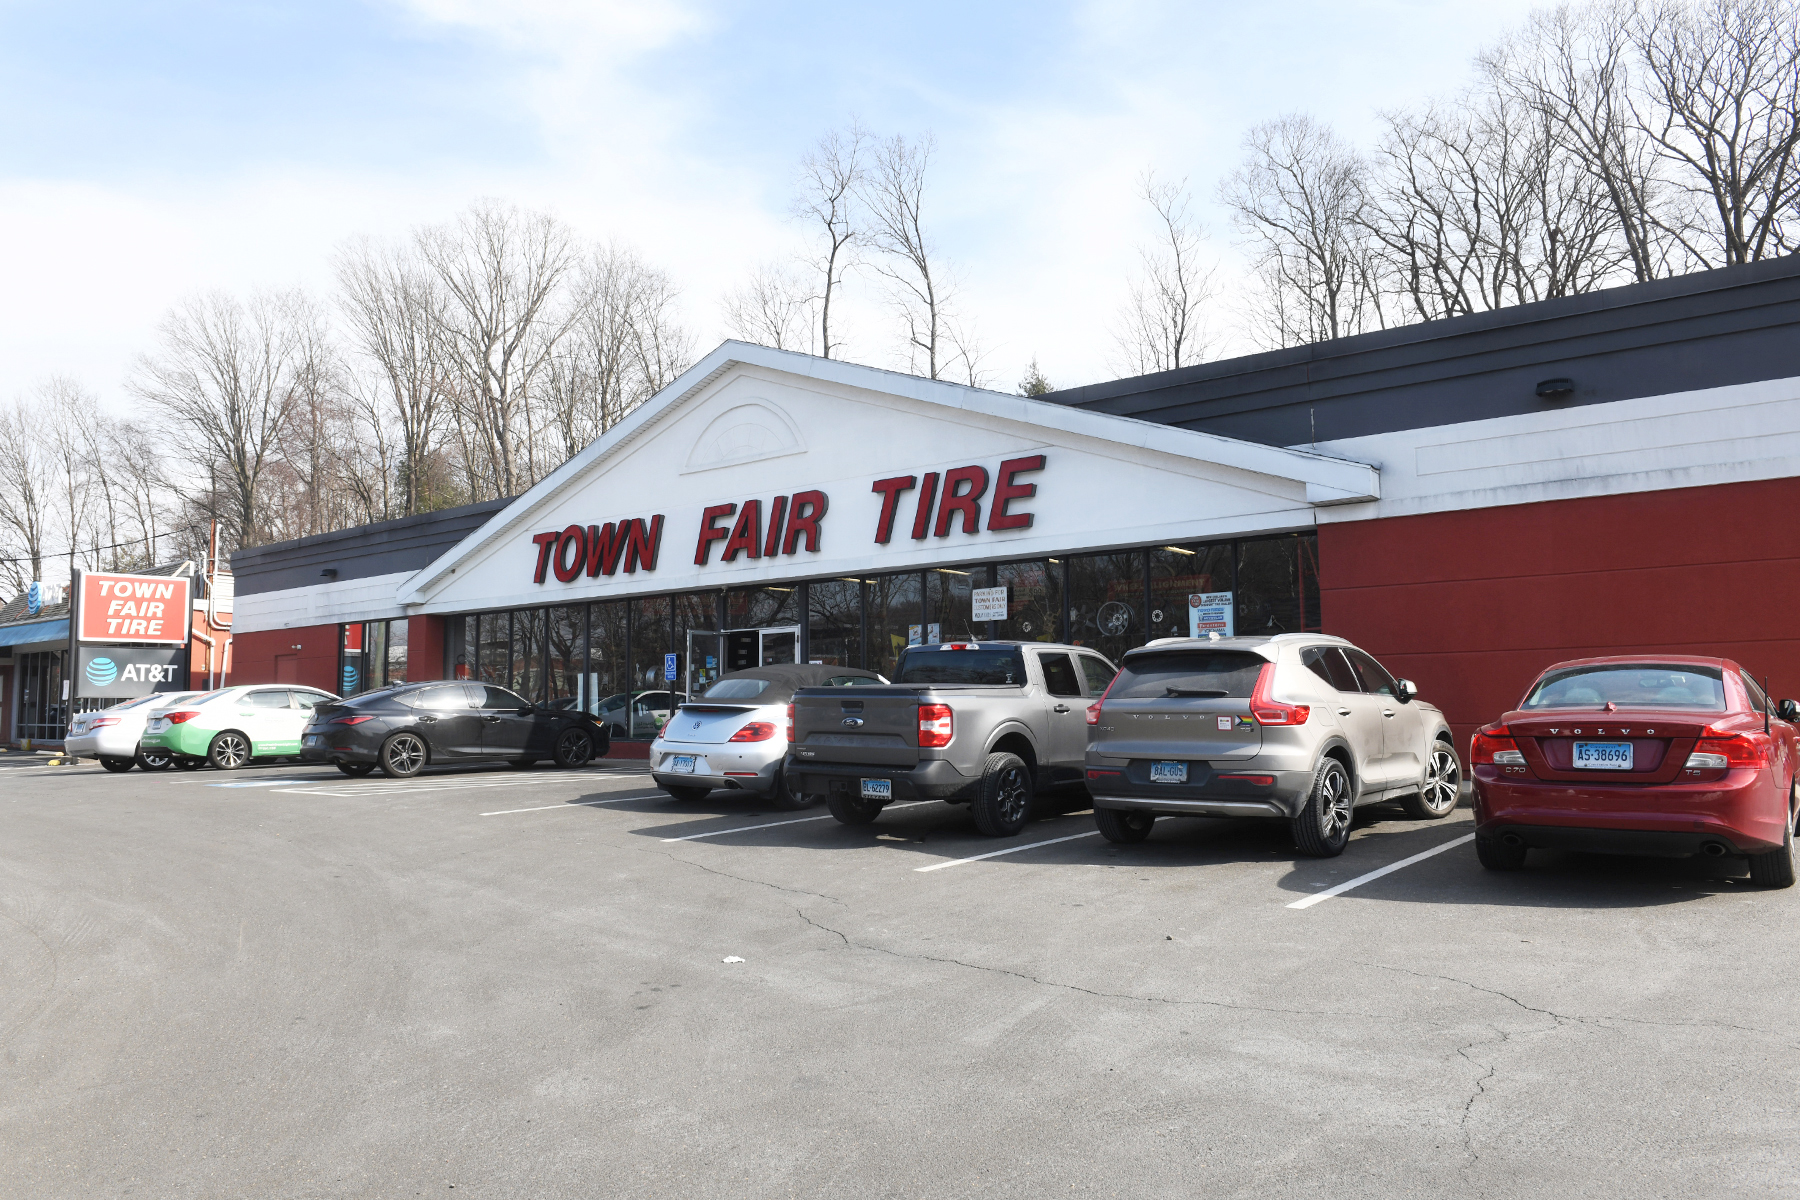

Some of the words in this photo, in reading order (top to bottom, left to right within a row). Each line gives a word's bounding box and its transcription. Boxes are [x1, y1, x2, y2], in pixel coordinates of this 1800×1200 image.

[532, 514, 665, 584] TOWN
[694, 489, 829, 565] FAIR
[872, 454, 1047, 544] TIRE
[98, 580, 175, 600] TOWN
[107, 600, 165, 617] FAIR
[106, 618, 165, 635] TIRE
[120, 663, 178, 682] AT&T
